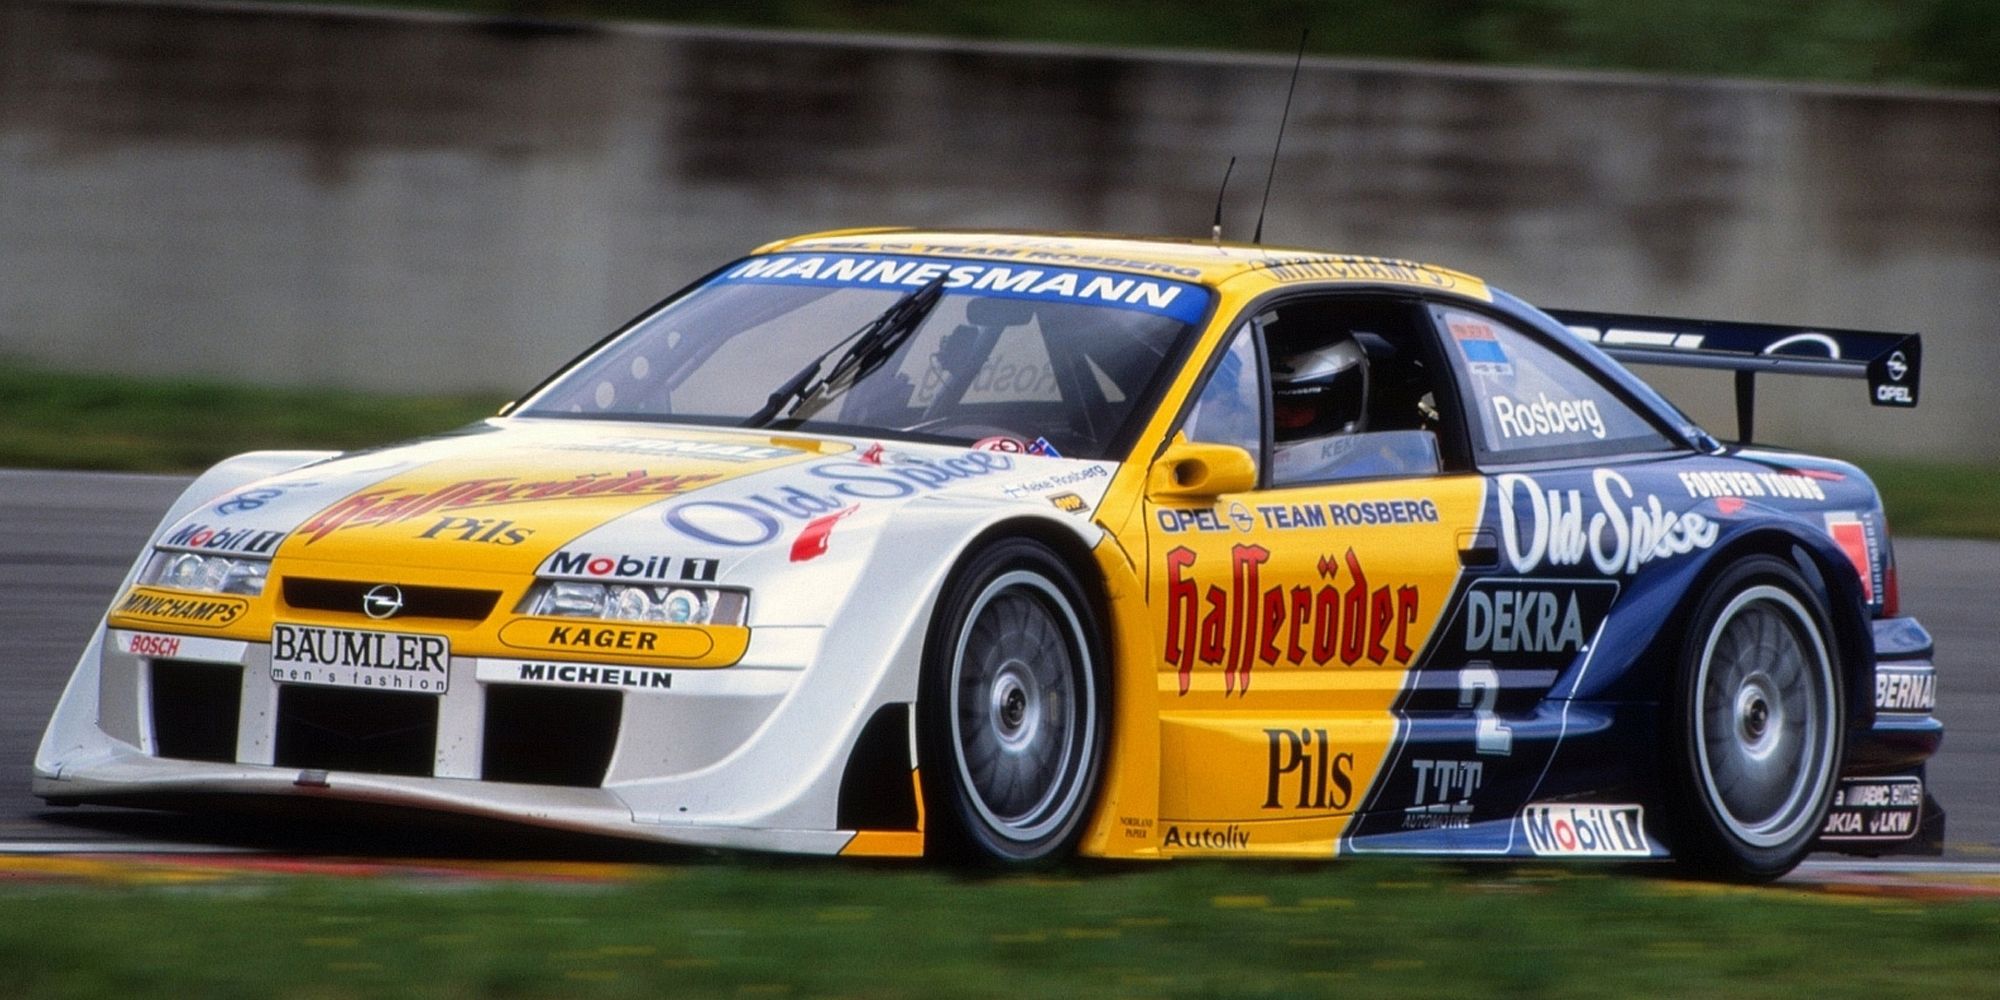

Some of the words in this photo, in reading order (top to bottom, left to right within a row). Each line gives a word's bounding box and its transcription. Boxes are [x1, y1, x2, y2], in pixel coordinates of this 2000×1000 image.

[730, 256, 1182, 308] MANNESMANN
[1877, 385, 1912, 402] OPEL
[1492, 392, 1606, 439] Rosberg
[1050, 464, 1108, 487] Rosberg
[1678, 471, 1765, 498] FOREVER
[1757, 472, 1826, 501] YOUNG
[664, 484, 842, 547] Old
[807, 451, 1013, 499] Spice
[1157, 508, 1230, 532] OPEL
[1257, 503, 1327, 529] TEAM
[1328, 499, 1440, 527] ROSBERG
[1497, 472, 1587, 574] Old
[1589, 468, 1719, 575] Spice
[167, 523, 254, 550] Mobil
[244, 530, 286, 552] 1
[414, 515, 536, 547] Pils
[548, 551, 671, 579] Mobil
[680, 558, 719, 581] 1
[121, 593, 243, 622] MINICHAMPS
[1465, 589, 1584, 652] DEKRA
[130, 634, 180, 656] BOSCH
[274, 625, 445, 673] BÄUMLER
[548, 627, 658, 650] KAGER
[272, 667, 336, 683] men's
[353, 671, 444, 690] fashion
[520, 664, 672, 689] MICHELIN
[1458, 660, 1513, 756] 2
[1261, 728, 1354, 811] Pils
[1163, 824, 1251, 849] Autoliv
[1401, 813, 1471, 830] AUTOMOTIVE
[1527, 807, 1615, 851] Mobil
[1612, 807, 1645, 850] 1
